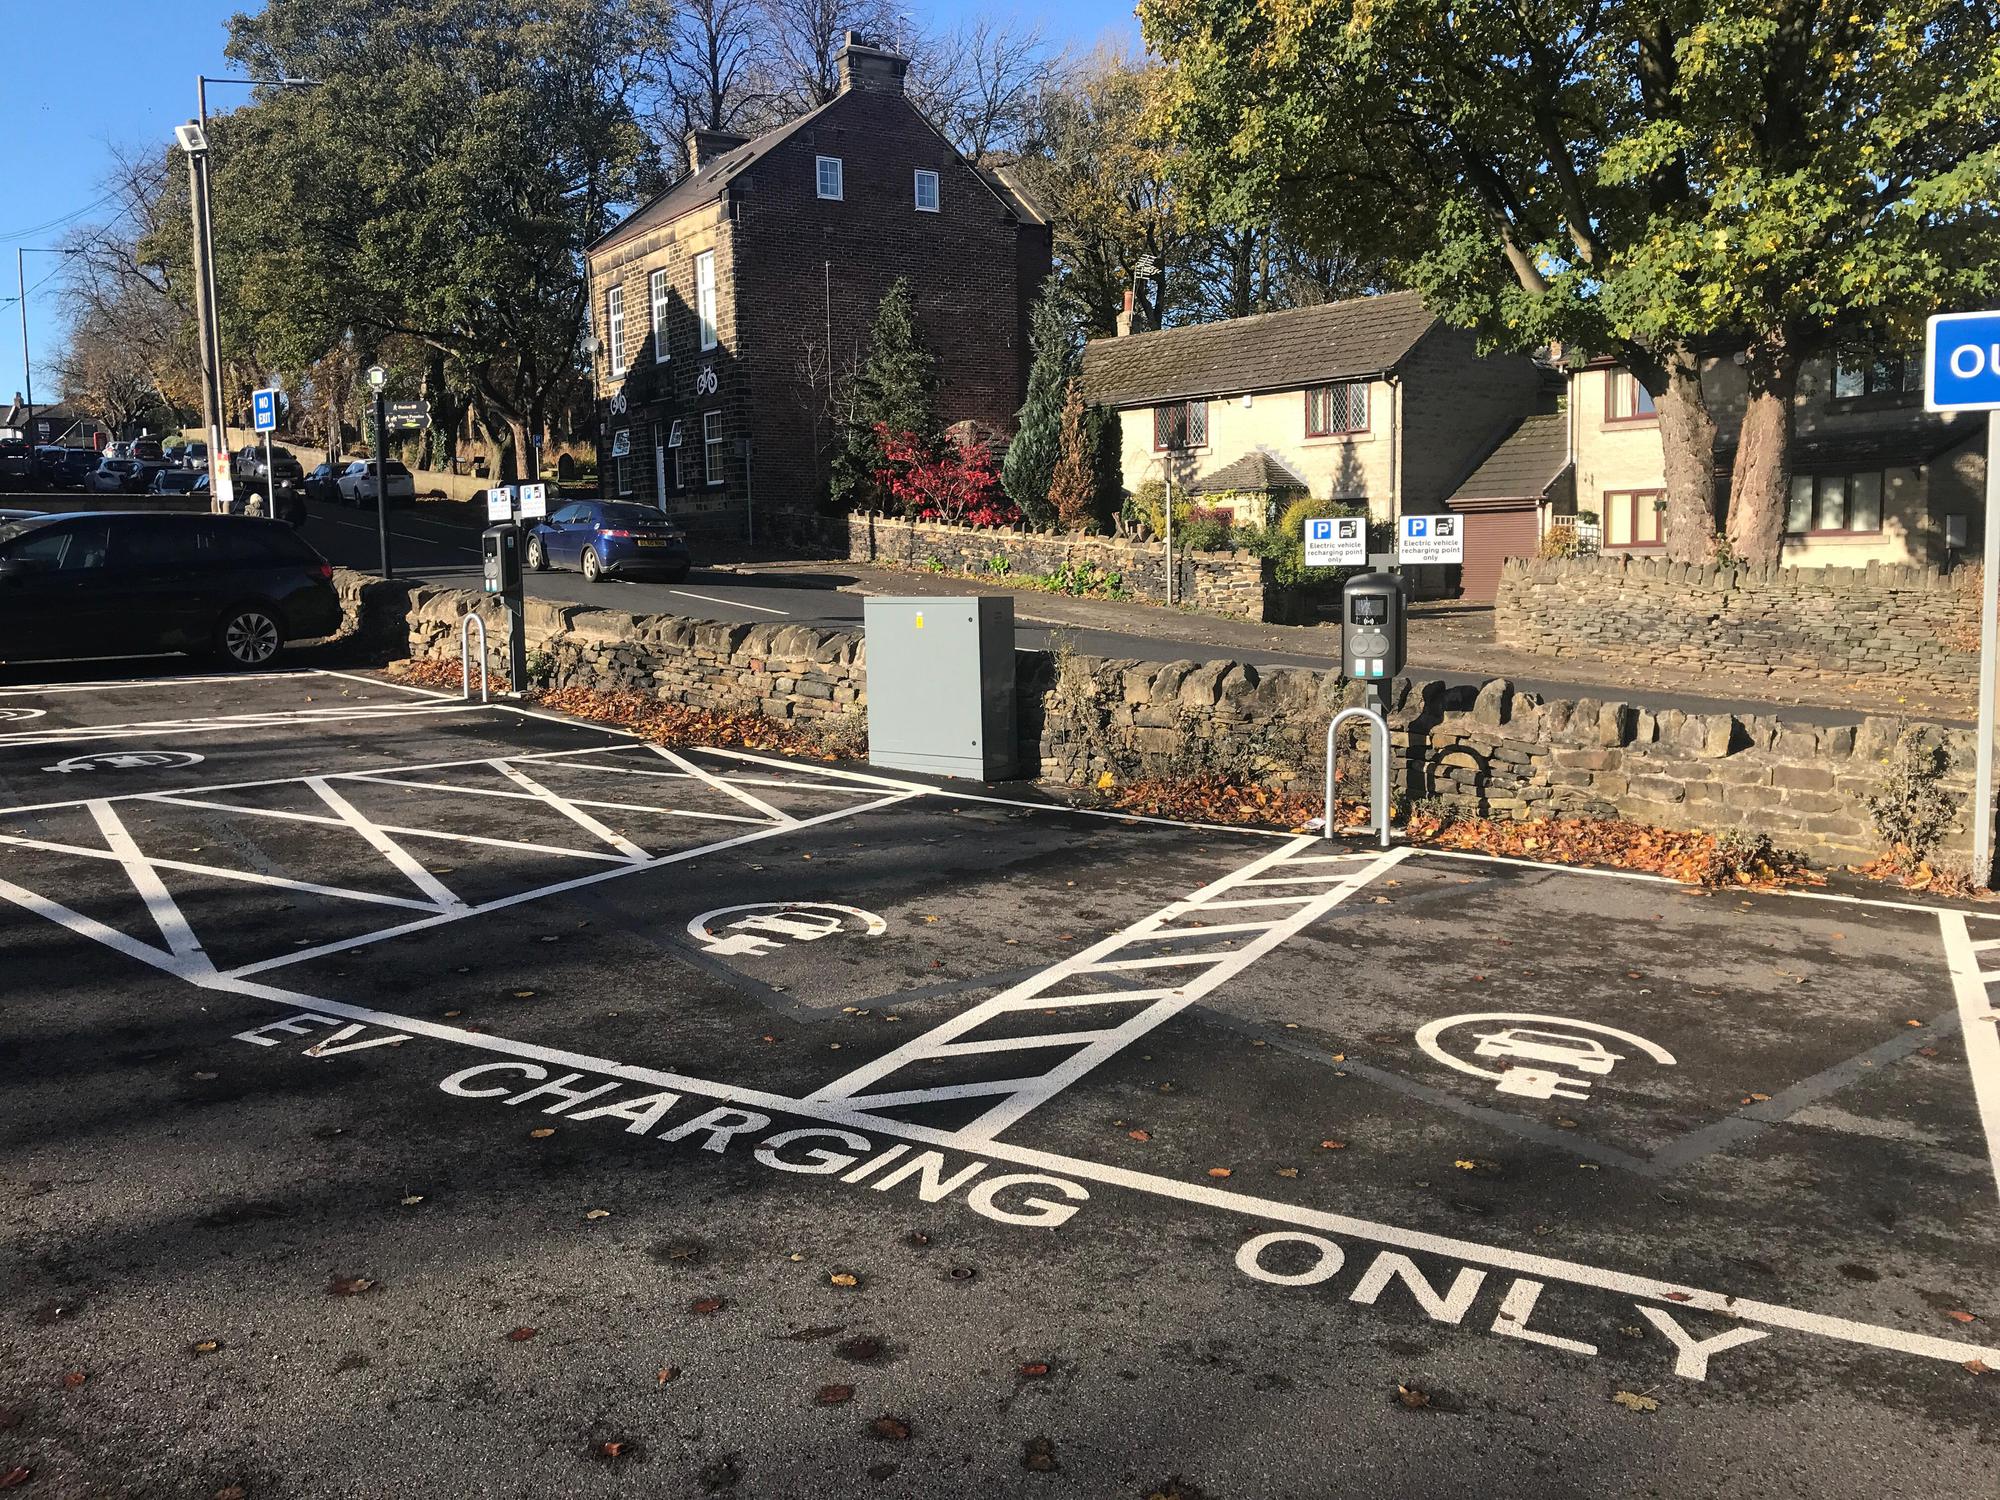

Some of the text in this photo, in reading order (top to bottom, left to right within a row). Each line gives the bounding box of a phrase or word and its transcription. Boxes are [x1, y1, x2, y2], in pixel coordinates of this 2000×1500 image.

[259, 396, 269, 409] NO
[258, 411, 271, 425] EXIT
[1317, 523, 1329, 539] P
[1412, 520, 1425, 535] P
[1307, 548, 1363, 557] recharging point
[1441, 546, 1461, 554] point
[1423, 554, 1439, 562] only
[231, 1013, 1772, 1382] EV CHARGING ONLY
